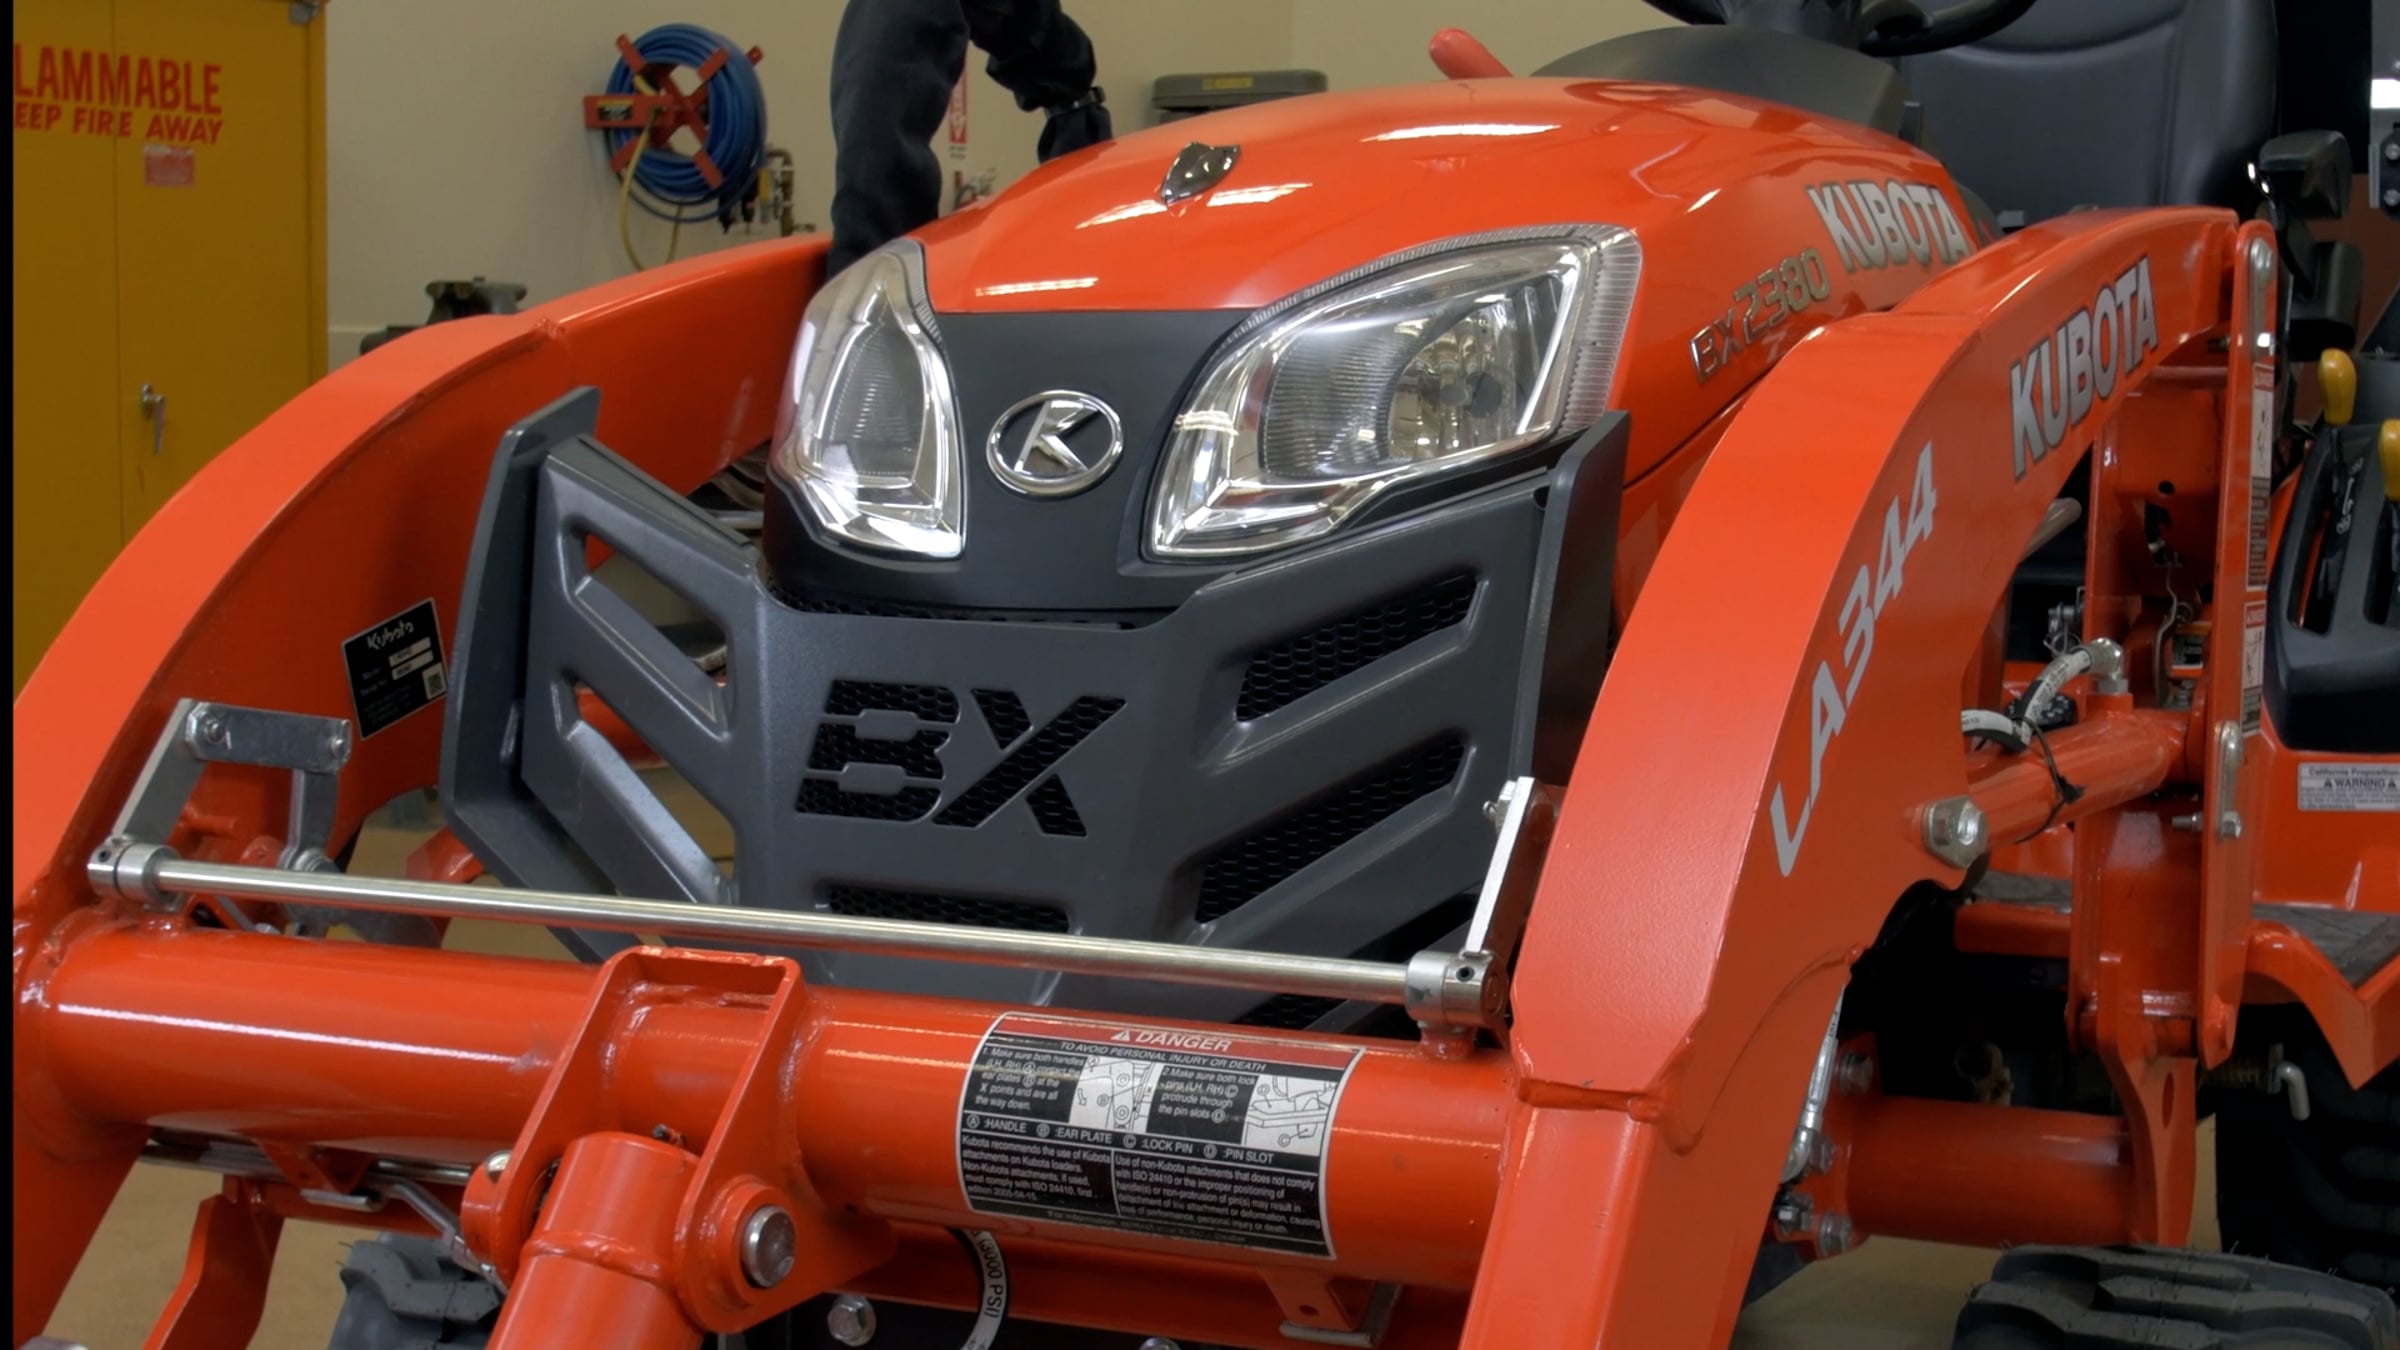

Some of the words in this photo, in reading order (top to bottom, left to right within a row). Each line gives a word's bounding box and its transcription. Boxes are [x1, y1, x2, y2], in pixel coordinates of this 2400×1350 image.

[13, 42, 222, 115] LAMMABLE
[14, 102, 62, 130] EEP
[73, 106, 132, 138] FIRE
[146, 114, 224, 145] AWAY
[1806, 179, 1971, 274] KUBOTA
[2010, 253, 2159, 483] KUBOTA
[1769, 440, 1937, 878] LA344
[795, 680, 1128, 838] BX
[2335, 778, 2386, 788] WARNING
[1060, 1041, 1075, 1052] TO
[1076, 1043, 1110, 1056] AVOID
[1111, 1046, 1167, 1062] PERSONAL
[1169, 1053, 1210, 1067] INJURY
[1212, 1057, 1227, 1068] OR
[1230, 1059, 1266, 1072] DEATH
[1135, 1030, 1232, 1052] DANGER
[991, 1049, 1013, 1058] Make
[1014, 1051, 1031, 1060] sure
[1033, 1053, 1051, 1062] both
[1053, 1055, 1084, 1066] handles
[976, 1095, 988, 1105] the
[989, 1098, 1005, 1109] way
[980, 1083, 987, 1092] X
[990, 1085, 1014, 1095] points
[1016, 1088, 1032, 1097] and
[1033, 1090, 1047, 1099] are
[1048, 1091, 1058, 1100] all
[1161, 1093, 1198, 1106] protrude
[1200, 1096, 1233, 1110] through
[962, 1136, 990, 1148] Kubota
[991, 1140, 1041, 1153] recommends
[1043, 1146, 1055, 1155] the
[1057, 1149, 1071, 1158] use
[1073, 1149, 1080, 1159] of
[1083, 1151, 1111, 1163] Kubota
[1081, 1129, 1113, 1144] PLATE
[1175, 1141, 1193, 1155] PIN
[1246, 1150, 1274, 1164] SLOT
[1116, 1155, 1130, 1166] Use
[1132, 1156, 1140, 1167] of
[1141, 1158, 1185, 1173] non-Kubota
[1187, 1163, 1233, 1180] attachments
[1235, 1169, 1249, 1180] that
[1251, 1171, 1270, 1184] does
[1273, 1175, 1284, 1186] not
[1286, 1177, 1315, 1191] comply
[1132, 1170, 1147, 1181] ISO
[1149, 1173, 1173, 1184] 24410
[1175, 1177, 1182, 1185] or
[1184, 1176, 1196, 1187] the
[1198, 1178, 1231, 1192] improper
[1233, 1184, 1274, 1199] positioning
[1277, 1188, 1285, 1199] of
